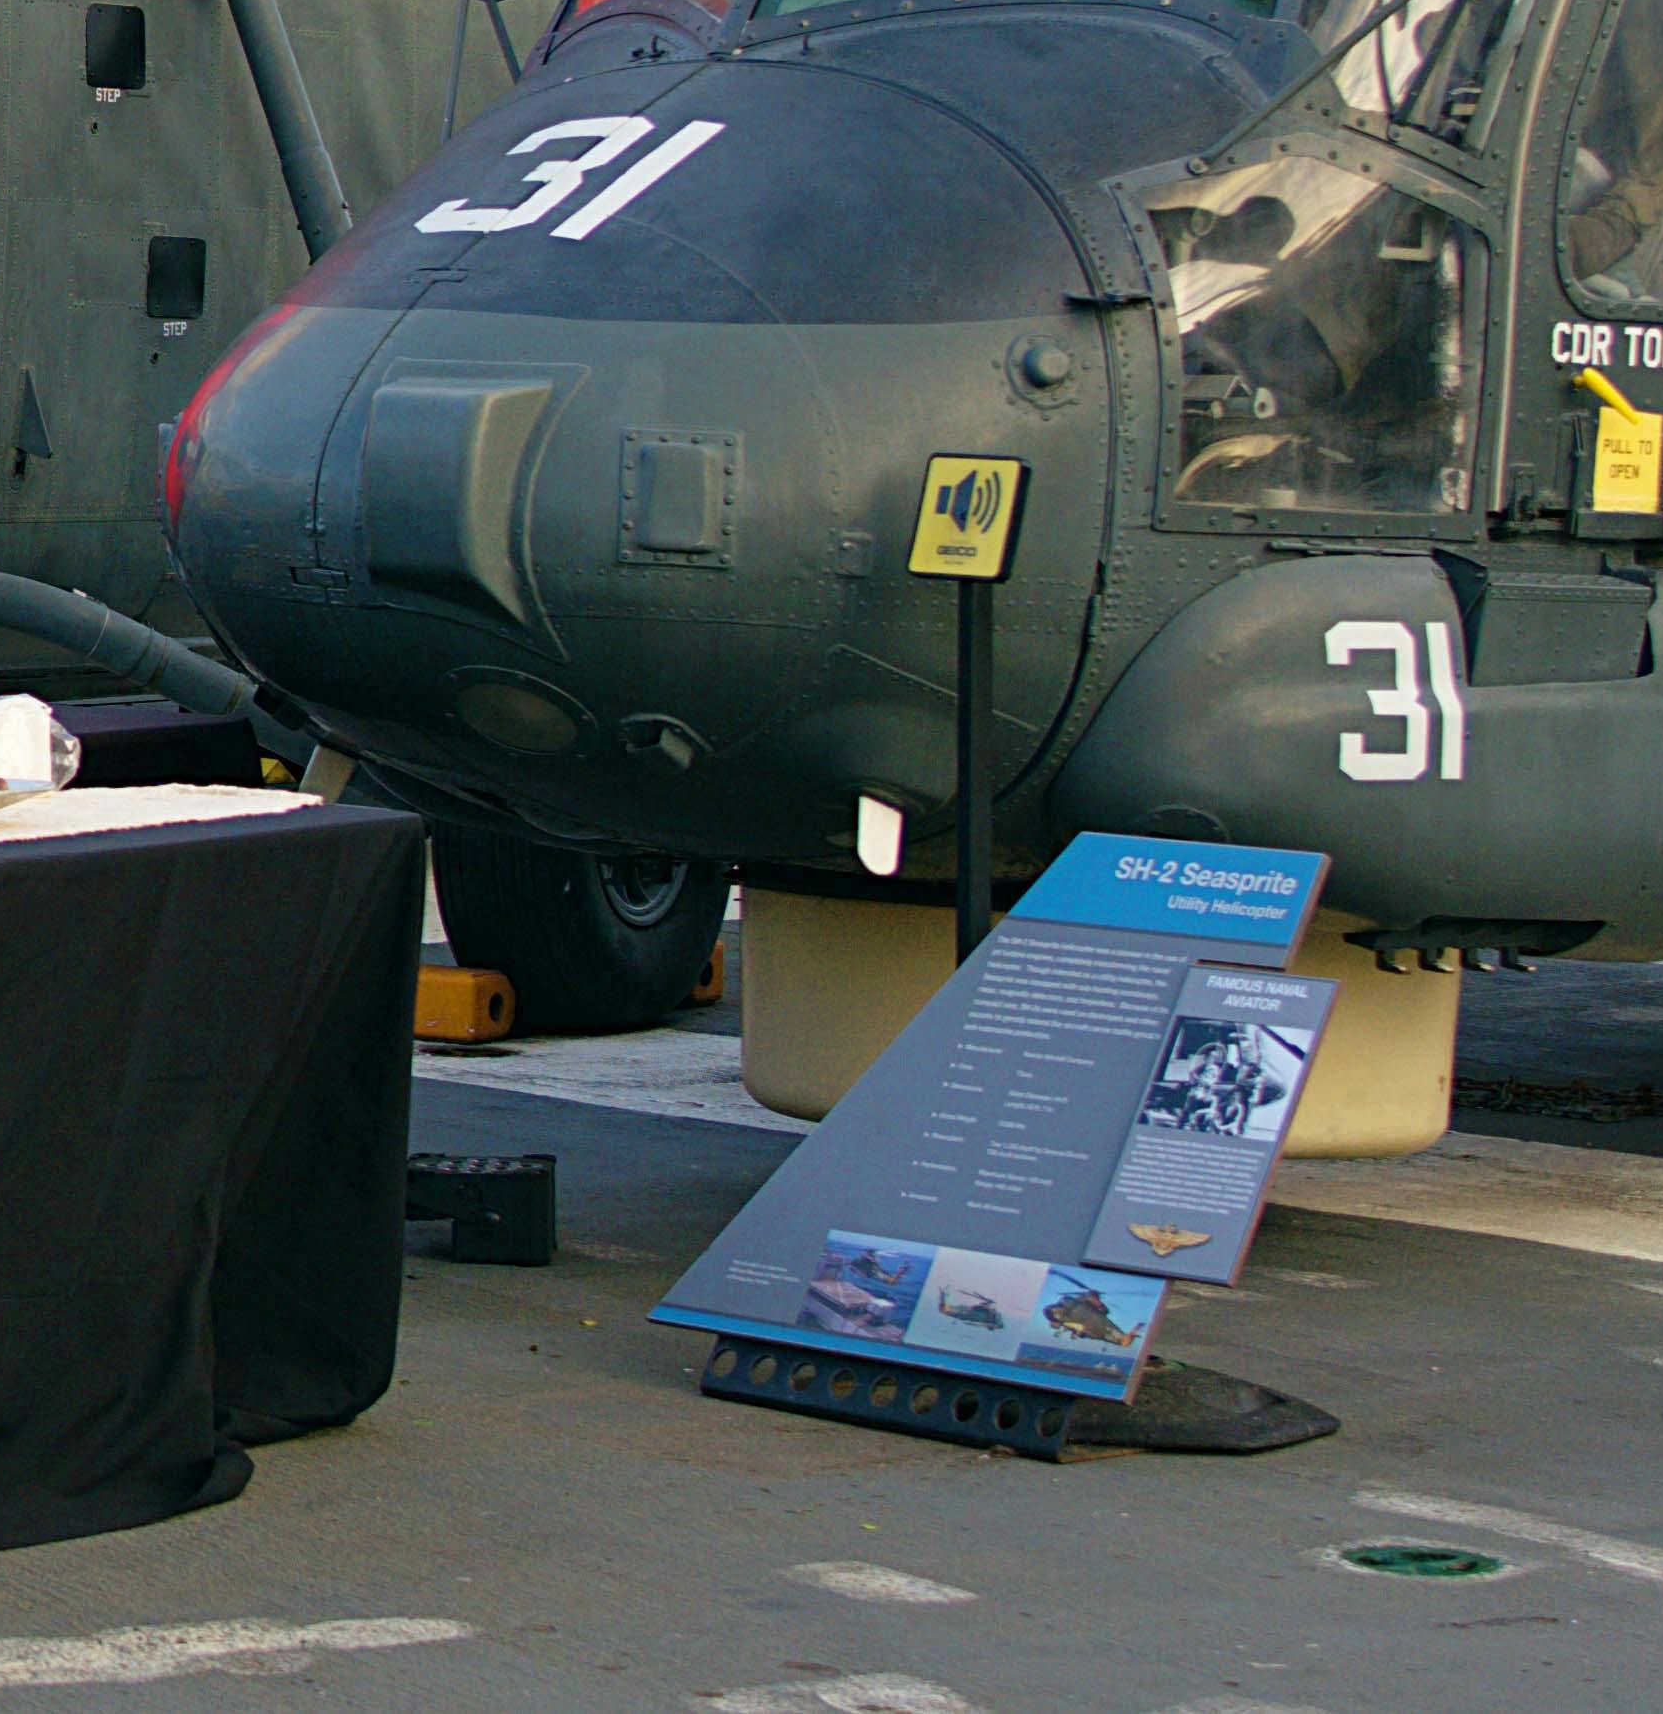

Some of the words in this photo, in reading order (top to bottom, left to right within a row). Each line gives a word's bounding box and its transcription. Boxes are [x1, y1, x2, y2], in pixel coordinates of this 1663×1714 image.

[95, 88, 121, 103] STEP
[414, 115, 726, 241] 31
[163, 322, 188, 337] STEP
[1552, 322, 1613, 366] CDR
[1603, 439, 1633, 455] PULL
[1636, 440, 1652, 456] TO
[1609, 464, 1640, 480] OPEN
[1325, 621, 1464, 781] 31
[1115, 856, 1178, 884] SH-2
[1180, 862, 1298, 896] Seasprite
[1167, 894, 1209, 915] Utility
[1211, 899, 1288, 920] Helicopter
[1206, 975, 1264, 993] FAMOUS
[1266, 980, 1309, 998] NAVAL
[1222, 995, 1282, 1012] AVIATOR
